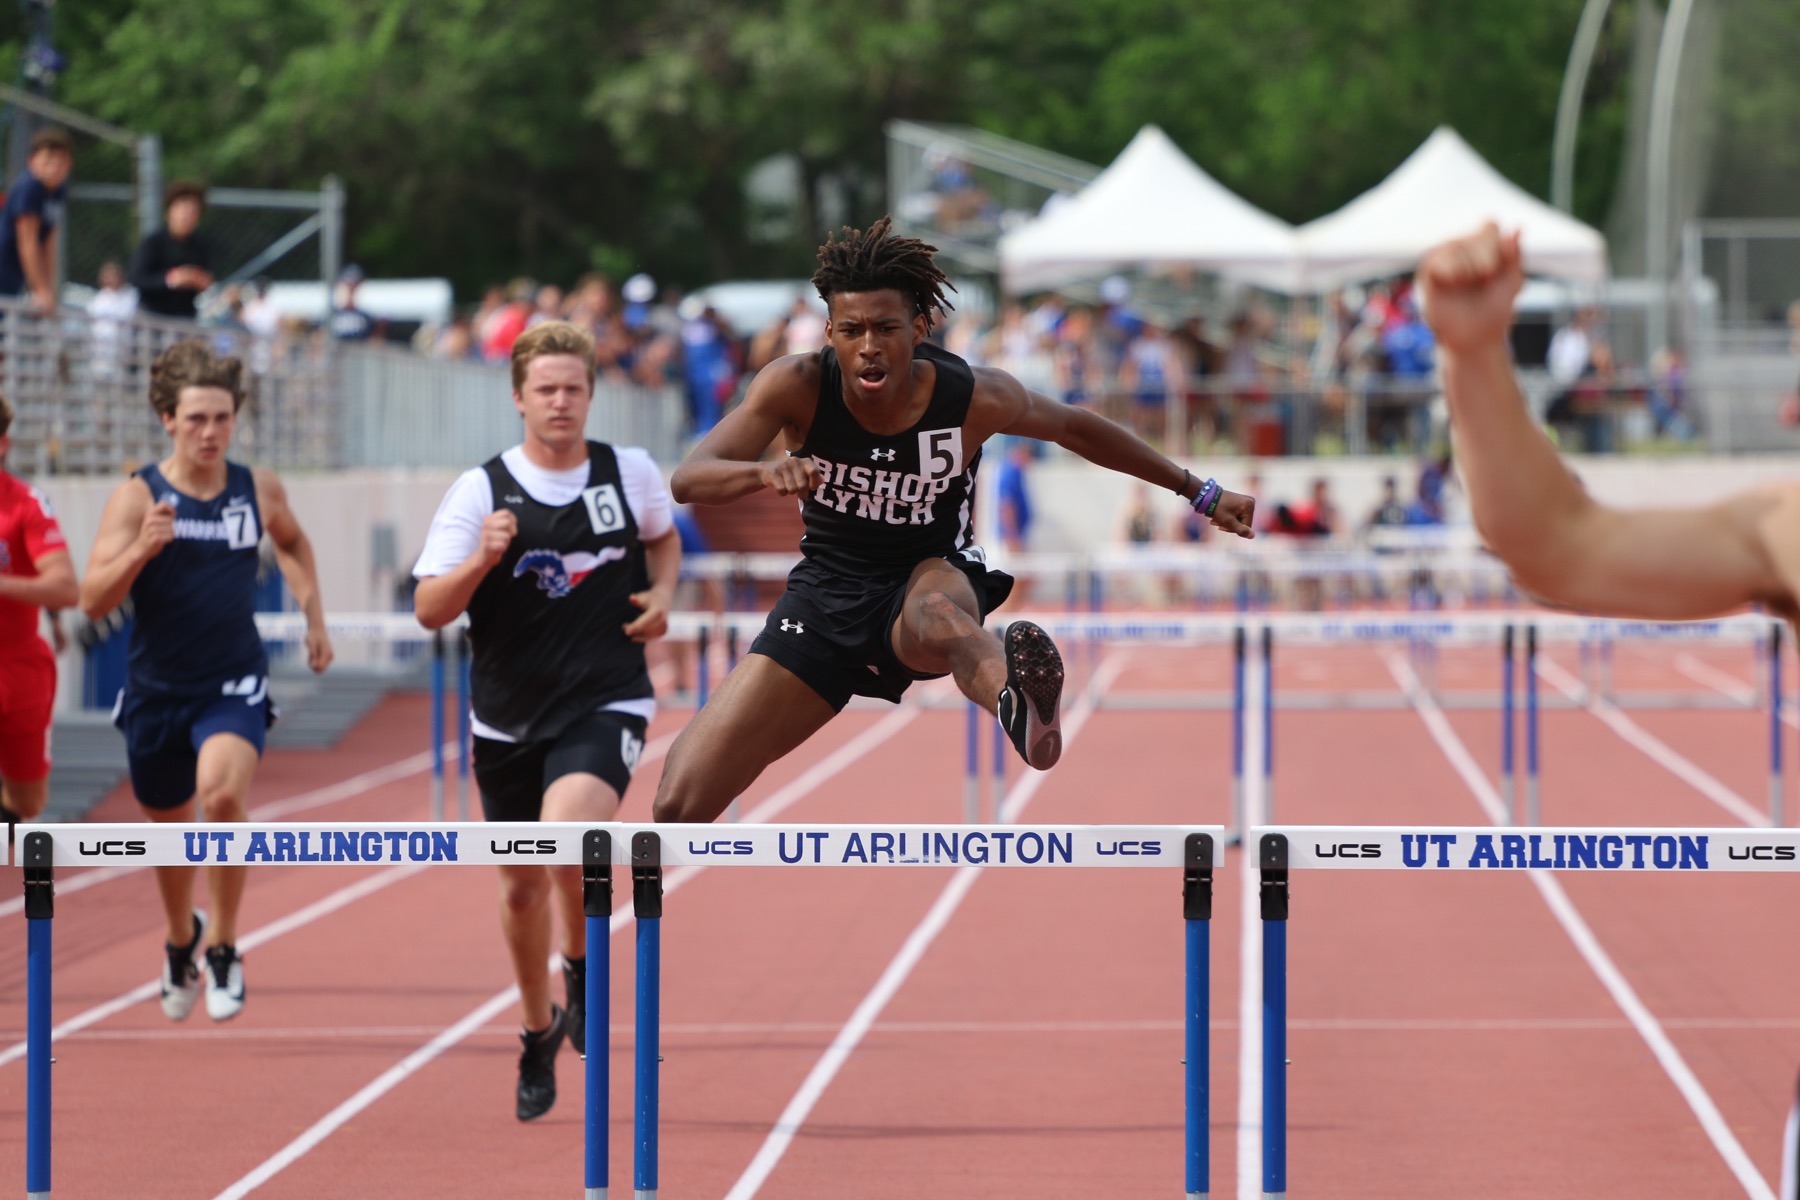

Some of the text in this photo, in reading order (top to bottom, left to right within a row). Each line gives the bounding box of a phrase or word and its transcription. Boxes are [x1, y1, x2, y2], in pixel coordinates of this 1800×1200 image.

[930, 432, 954, 480] 5
[812, 454, 949, 502] BISHOP
[594, 490, 616, 527] 6
[814, 483, 936, 525] LYNCH
[228, 511, 247, 544] 7
[80, 832, 557, 862] UCS UT ARLINGTON UCS
[689, 832, 1161, 864] UCS UT ARLINGTON UCS
[1316, 835, 1795, 869] UCS UT ARLINGTON UCS
